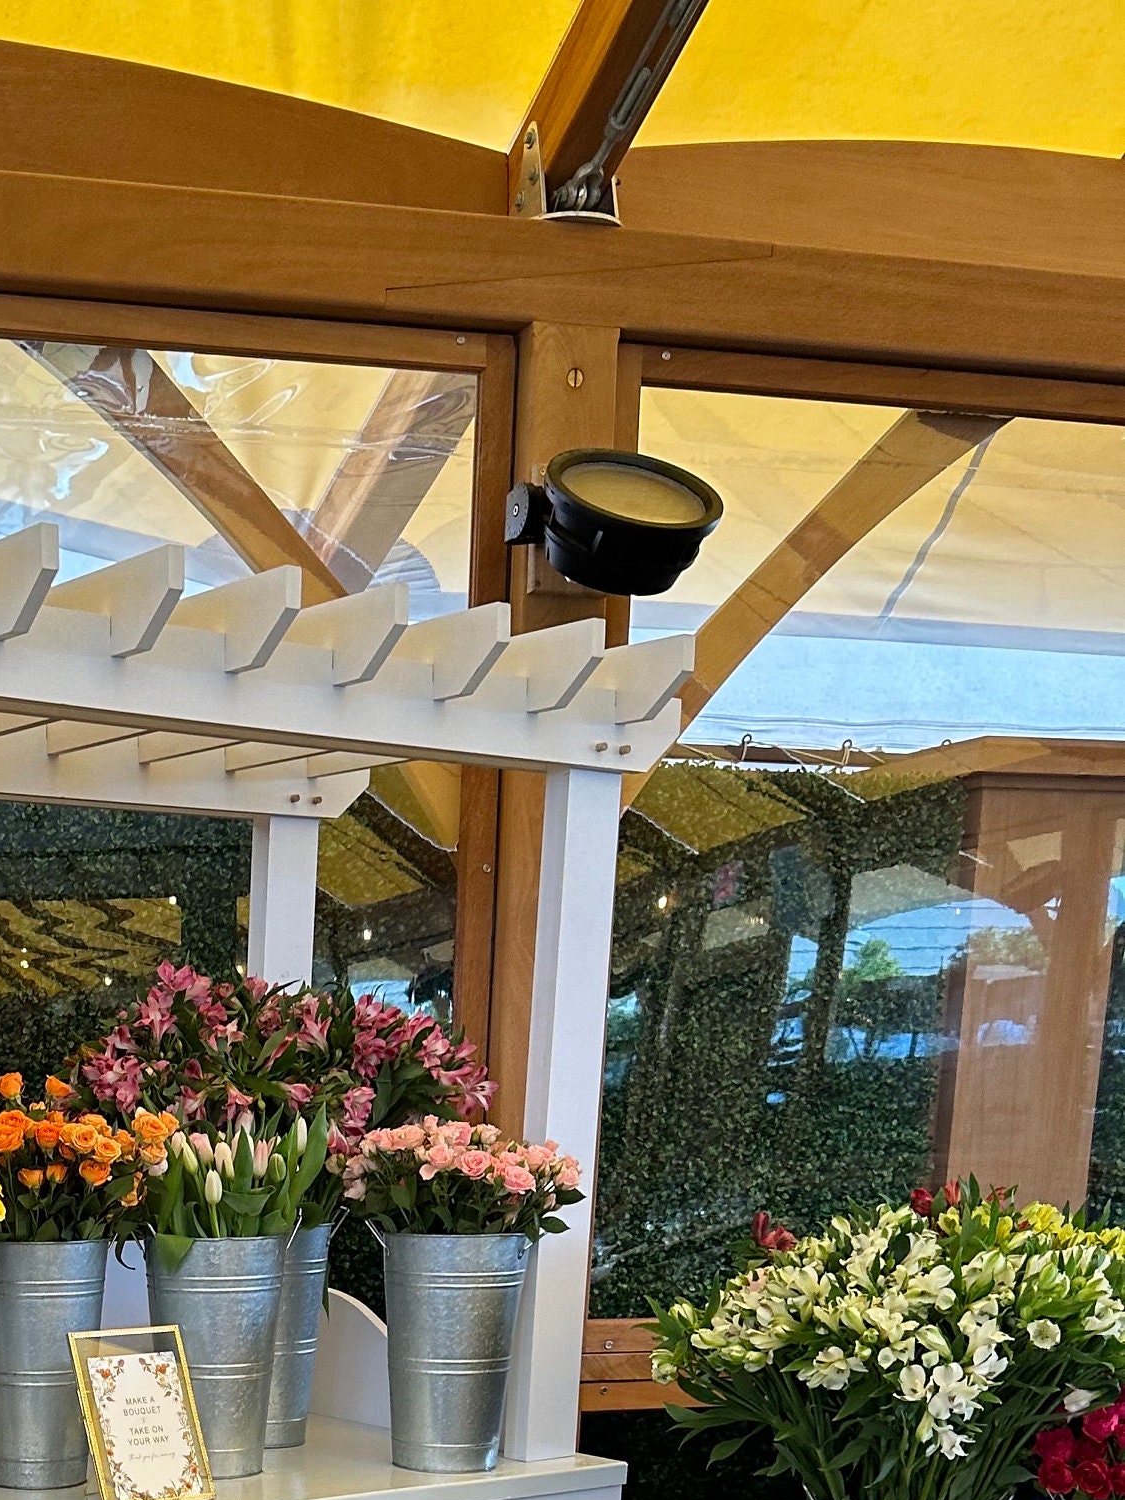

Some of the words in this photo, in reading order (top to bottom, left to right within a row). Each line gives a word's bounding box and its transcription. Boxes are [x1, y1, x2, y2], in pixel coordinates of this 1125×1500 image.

[126, 1396, 147, 1404] MAKE
[123, 1406, 161, 1416] BOUQUET
[129, 1426, 150, 1435] TAKE
[152, 1425, 164, 1433] ON
[128, 1437, 151, 1445] YOUR
[153, 1435, 169, 1443] WAY
